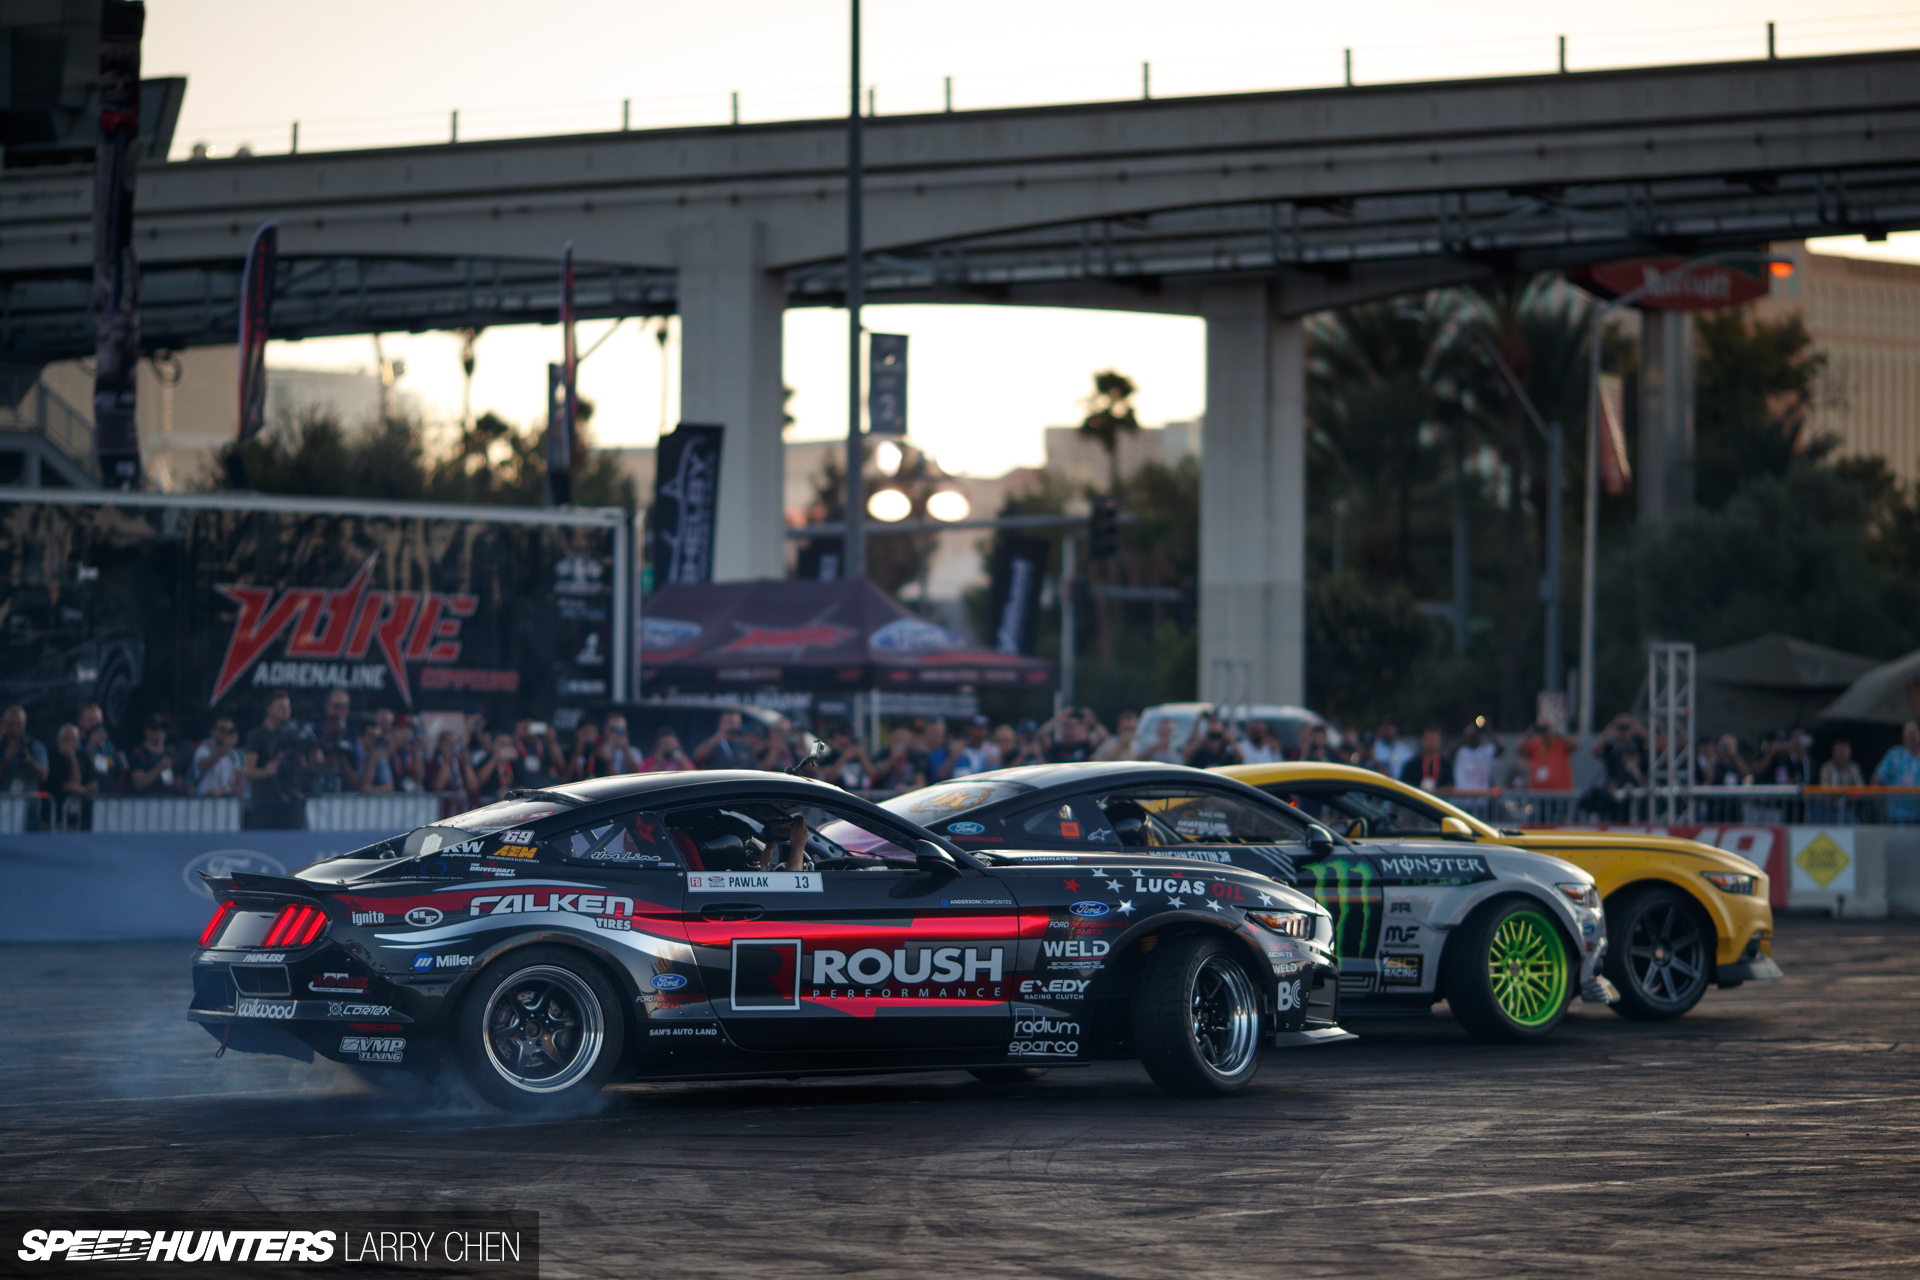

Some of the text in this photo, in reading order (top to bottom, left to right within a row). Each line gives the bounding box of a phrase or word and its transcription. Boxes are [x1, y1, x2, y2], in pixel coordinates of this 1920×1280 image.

[253, 663, 387, 691] ADRENALINE
[504, 831, 532, 844] 69
[492, 845, 538, 858] AEM
[591, 851, 662, 861] Hot Line
[469, 866, 516, 874] DRIVESHAFT
[729, 877, 769, 888] PAWLAK
[795, 876, 809, 888] 13
[1401, 877, 1473, 886] ENERGY
[1135, 878, 1245, 901] LUCAS OIL
[469, 894, 635, 917] FALKEN
[352, 911, 385, 926] ignite
[596, 917, 632, 931] TIRES
[1043, 940, 1110, 957] WELD
[242, 953, 286, 963] PAINLESS
[435, 954, 475, 968] Miller
[812, 947, 1004, 984] ROUSH
[1272, 963, 1297, 974] WELD
[1384, 968, 1418, 978] RACING
[1020, 979, 1091, 993] EXEDY
[636, 995, 653, 1003] FORD
[812, 987, 1002, 999] PERFORMANCE
[238, 998, 298, 1019] wilwood
[657, 1002, 680, 1010] PARTS
[649, 1028, 718, 1036] SAM'S AUTO LAND
[1015, 1016, 1080, 1035] radium
[360, 1039, 404, 1052] VMP
[1008, 1041, 1079, 1056] sparco
[361, 1052, 402, 1061] TUNING
